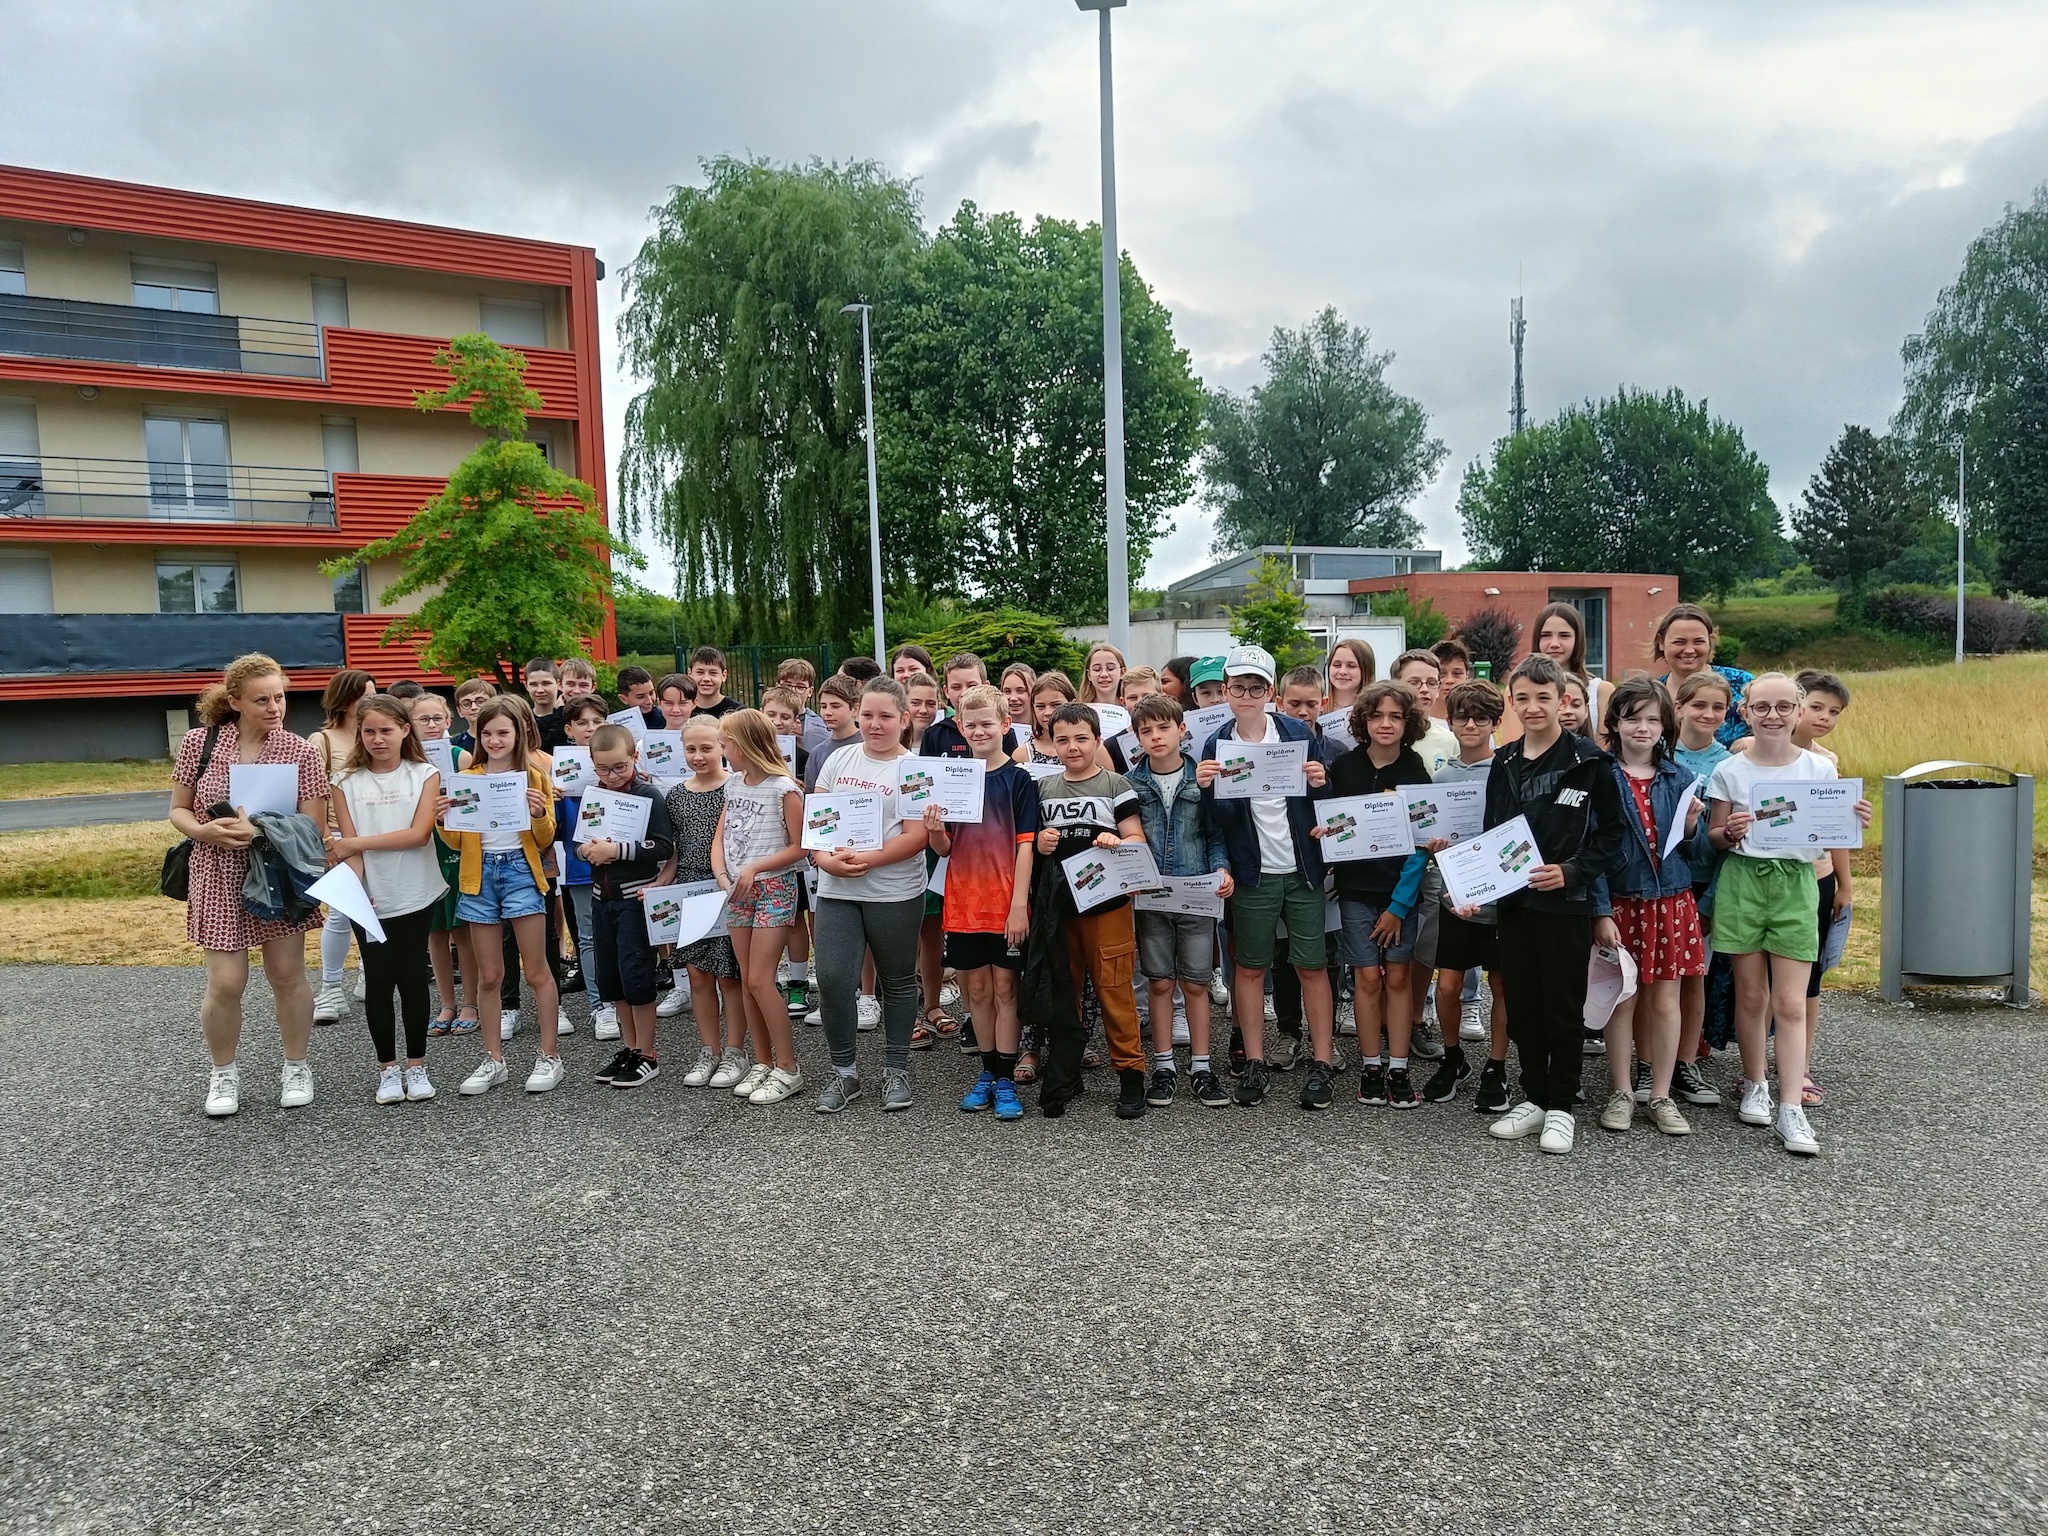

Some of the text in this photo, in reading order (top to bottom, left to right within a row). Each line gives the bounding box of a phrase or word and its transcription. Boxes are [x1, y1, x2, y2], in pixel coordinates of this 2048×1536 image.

[1101, 709, 1123, 718] Diplôme
[1199, 712, 1225, 723] Diplôme
[1321, 717, 1345, 728] Diplôme
[1446, 790, 1477, 798] Diplôme
[1554, 788, 1588, 807] NIKE
[1810, 788, 1846, 797] Diplôme
[614, 799, 639, 809] Diplôme
[849, 797, 872, 805] Diplôme
[1364, 801, 1394, 810] Diplôme
[1040, 801, 1097, 821] NASA
[1465, 884, 1496, 898] Diplôme
